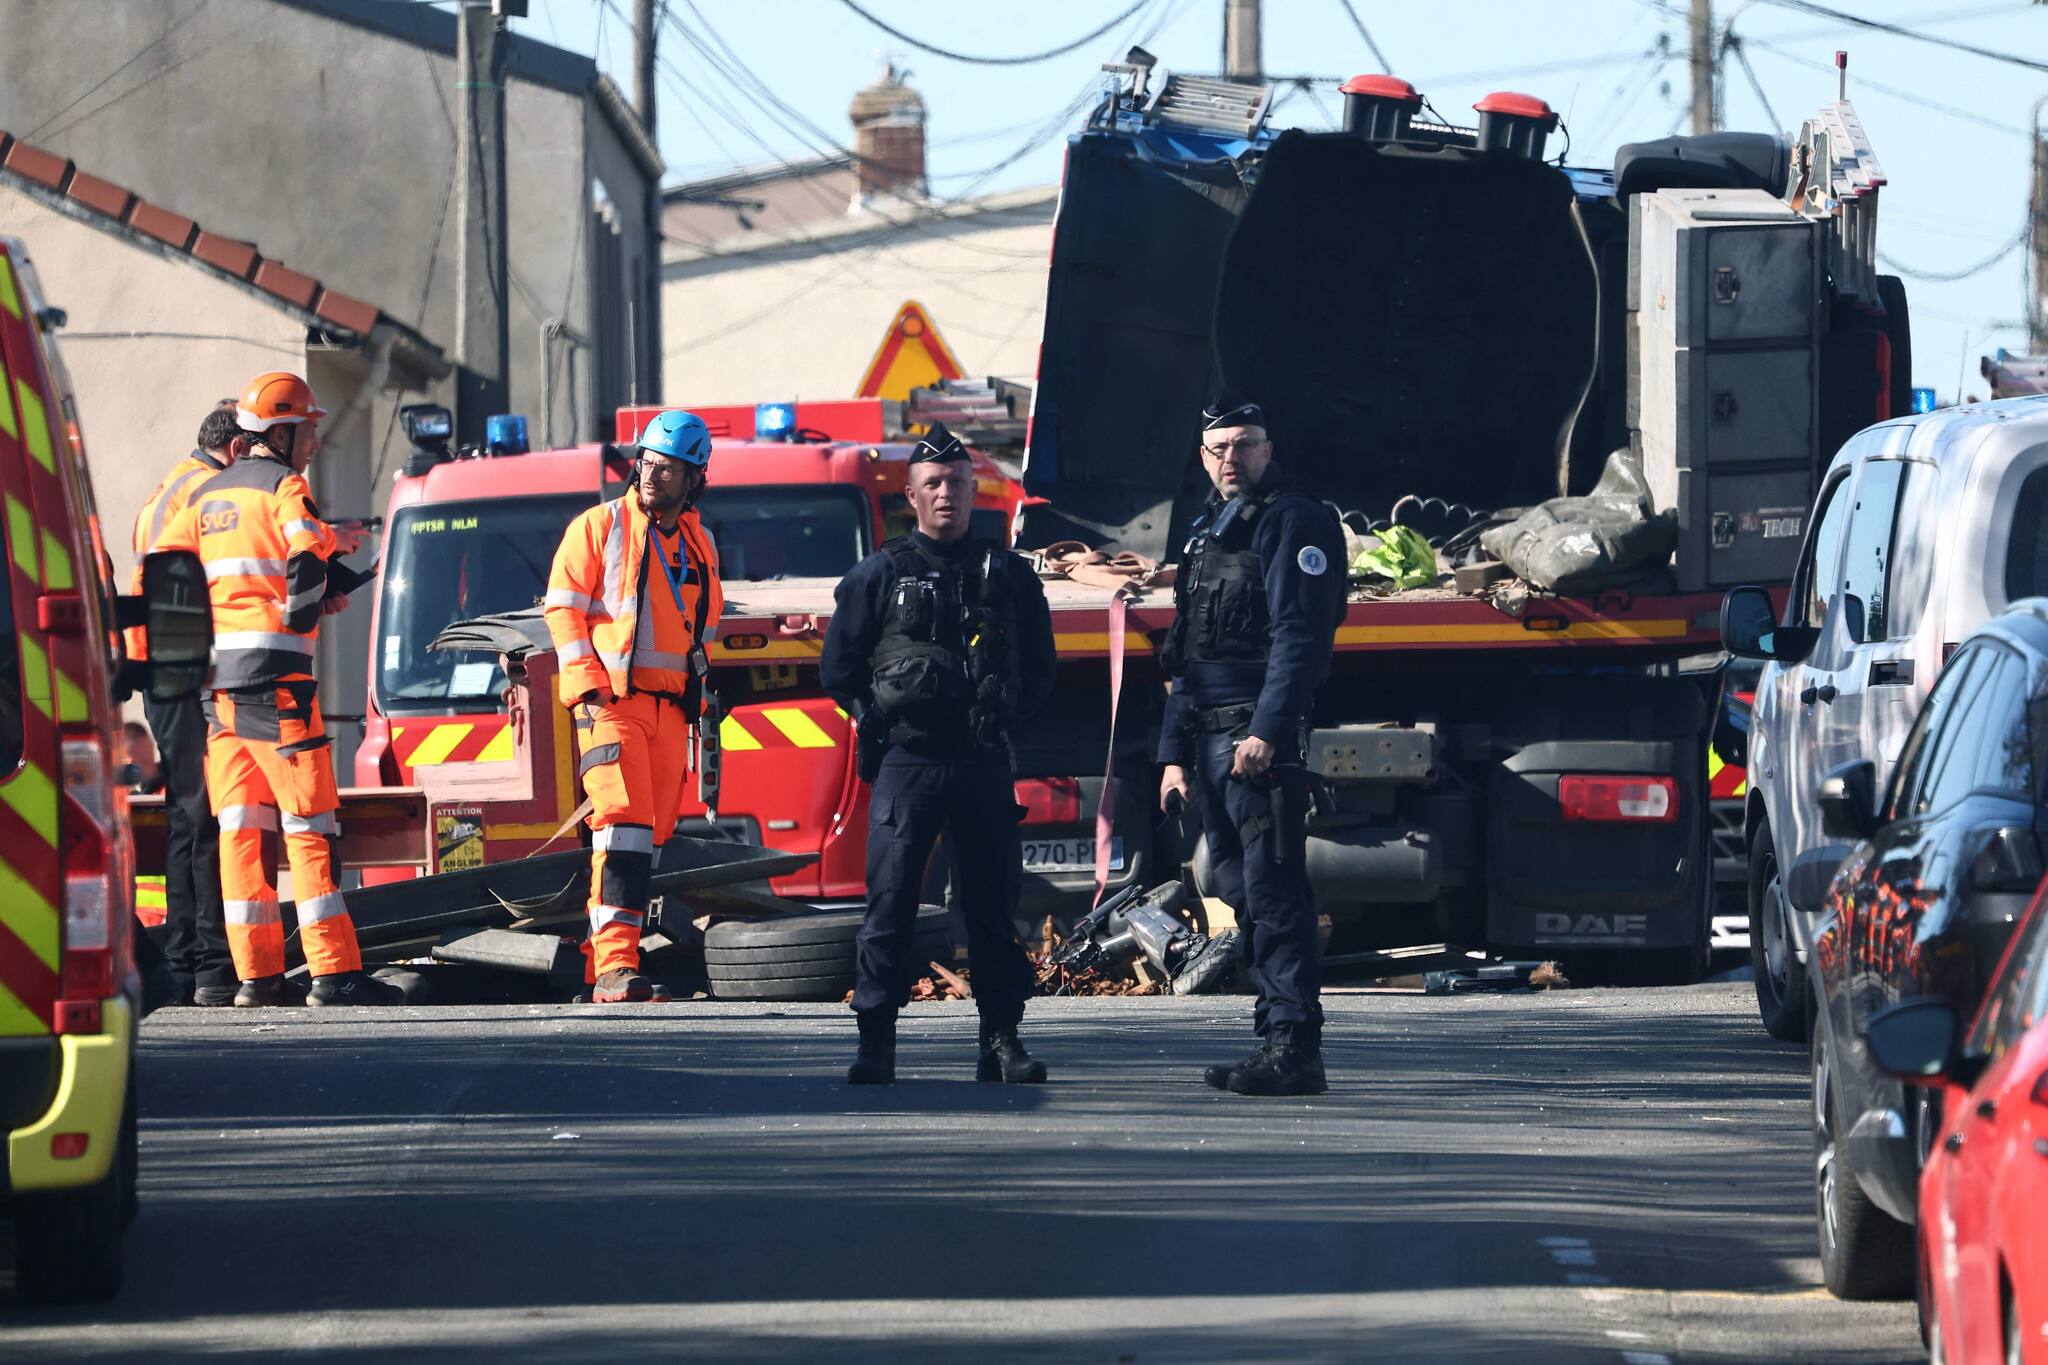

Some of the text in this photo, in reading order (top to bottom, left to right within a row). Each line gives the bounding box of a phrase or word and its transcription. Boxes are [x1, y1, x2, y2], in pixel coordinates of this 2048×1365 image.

[201, 509, 240, 532] SNCF
[452, 517, 478, 530] NLM
[1761, 518, 1802, 538] TECH
[436, 808, 482, 816] ATTENTION
[1536, 913, 1647, 934] DAF
